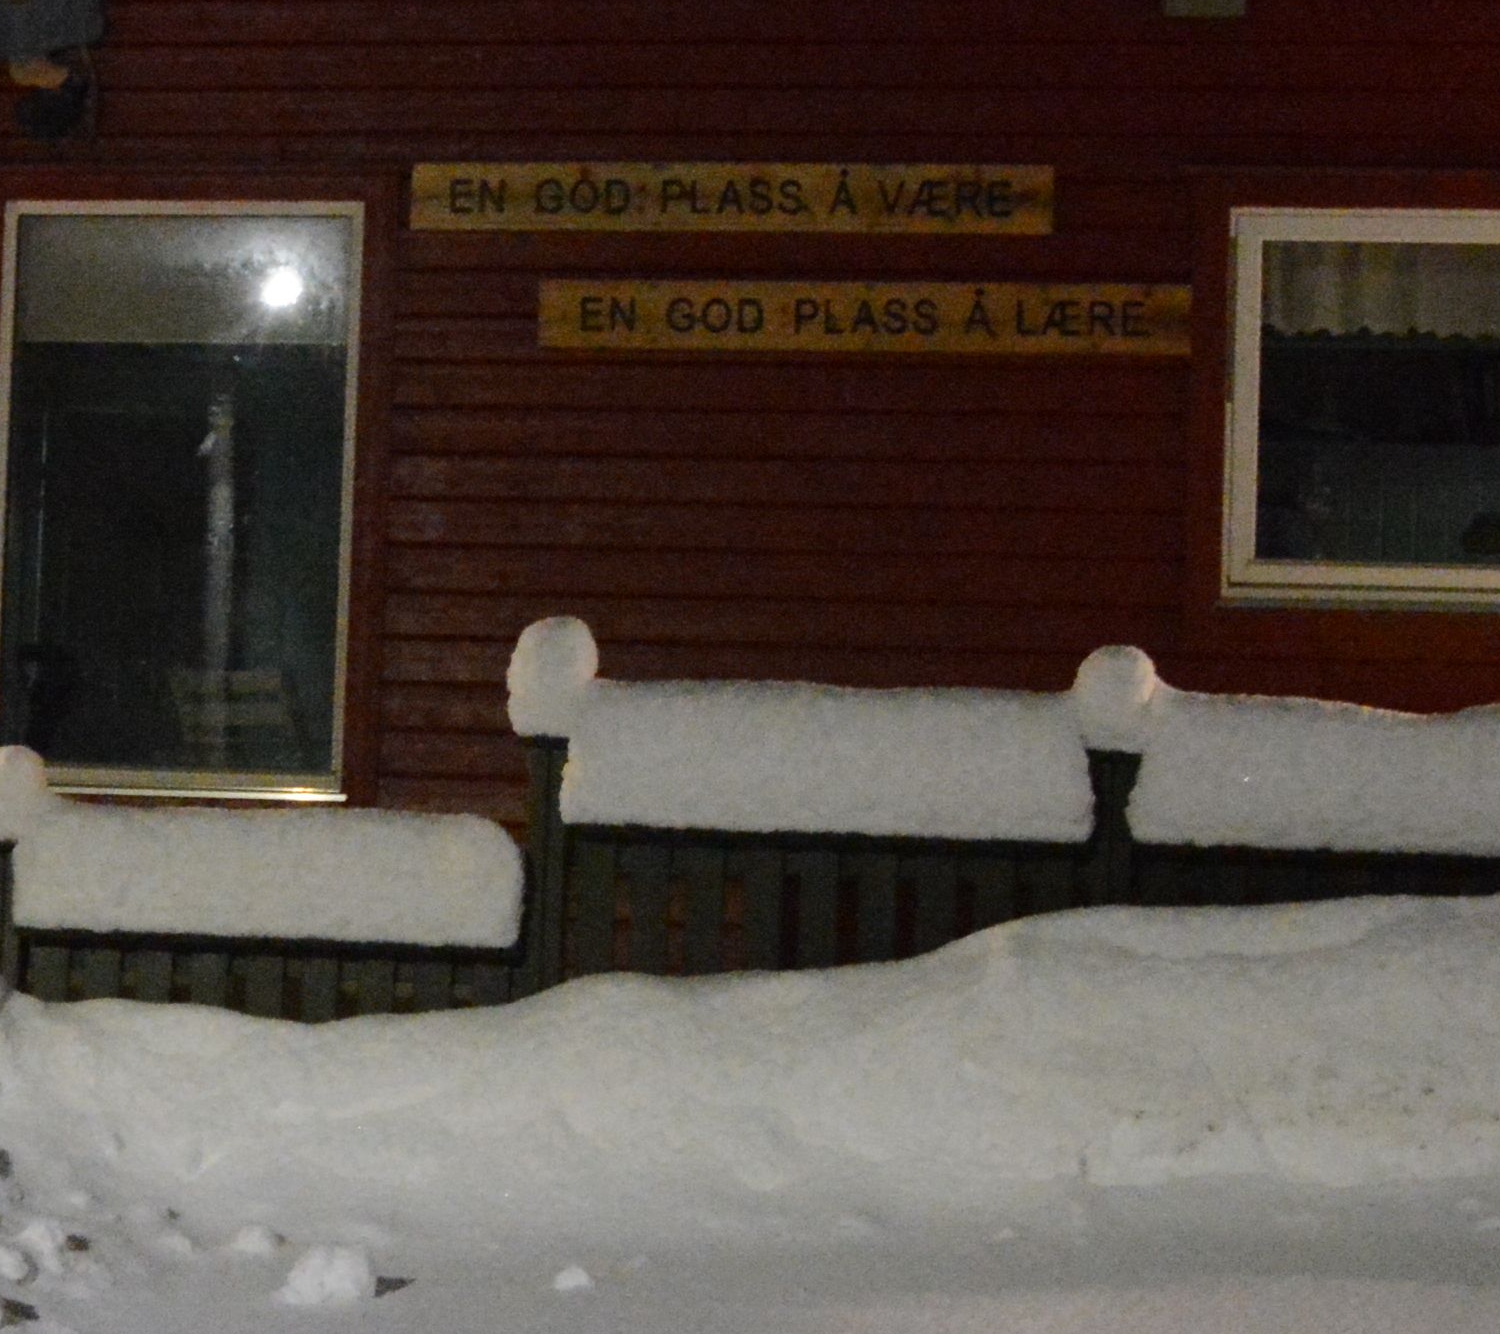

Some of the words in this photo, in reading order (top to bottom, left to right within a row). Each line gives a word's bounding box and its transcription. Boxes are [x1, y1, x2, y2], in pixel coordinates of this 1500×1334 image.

[450, 178, 505, 214] EN
[535, 177, 631, 215] GOD
[661, 178, 806, 216] PLASS
[829, 168, 857, 215] Å
[877, 179, 1013, 218] VÆRE
[579, 295, 636, 332] EN
[665, 297, 764, 333] GOD
[794, 298, 939, 335] PLASS
[965, 287, 997, 338] Å
[1015, 299, 1151, 337] LÆRE
